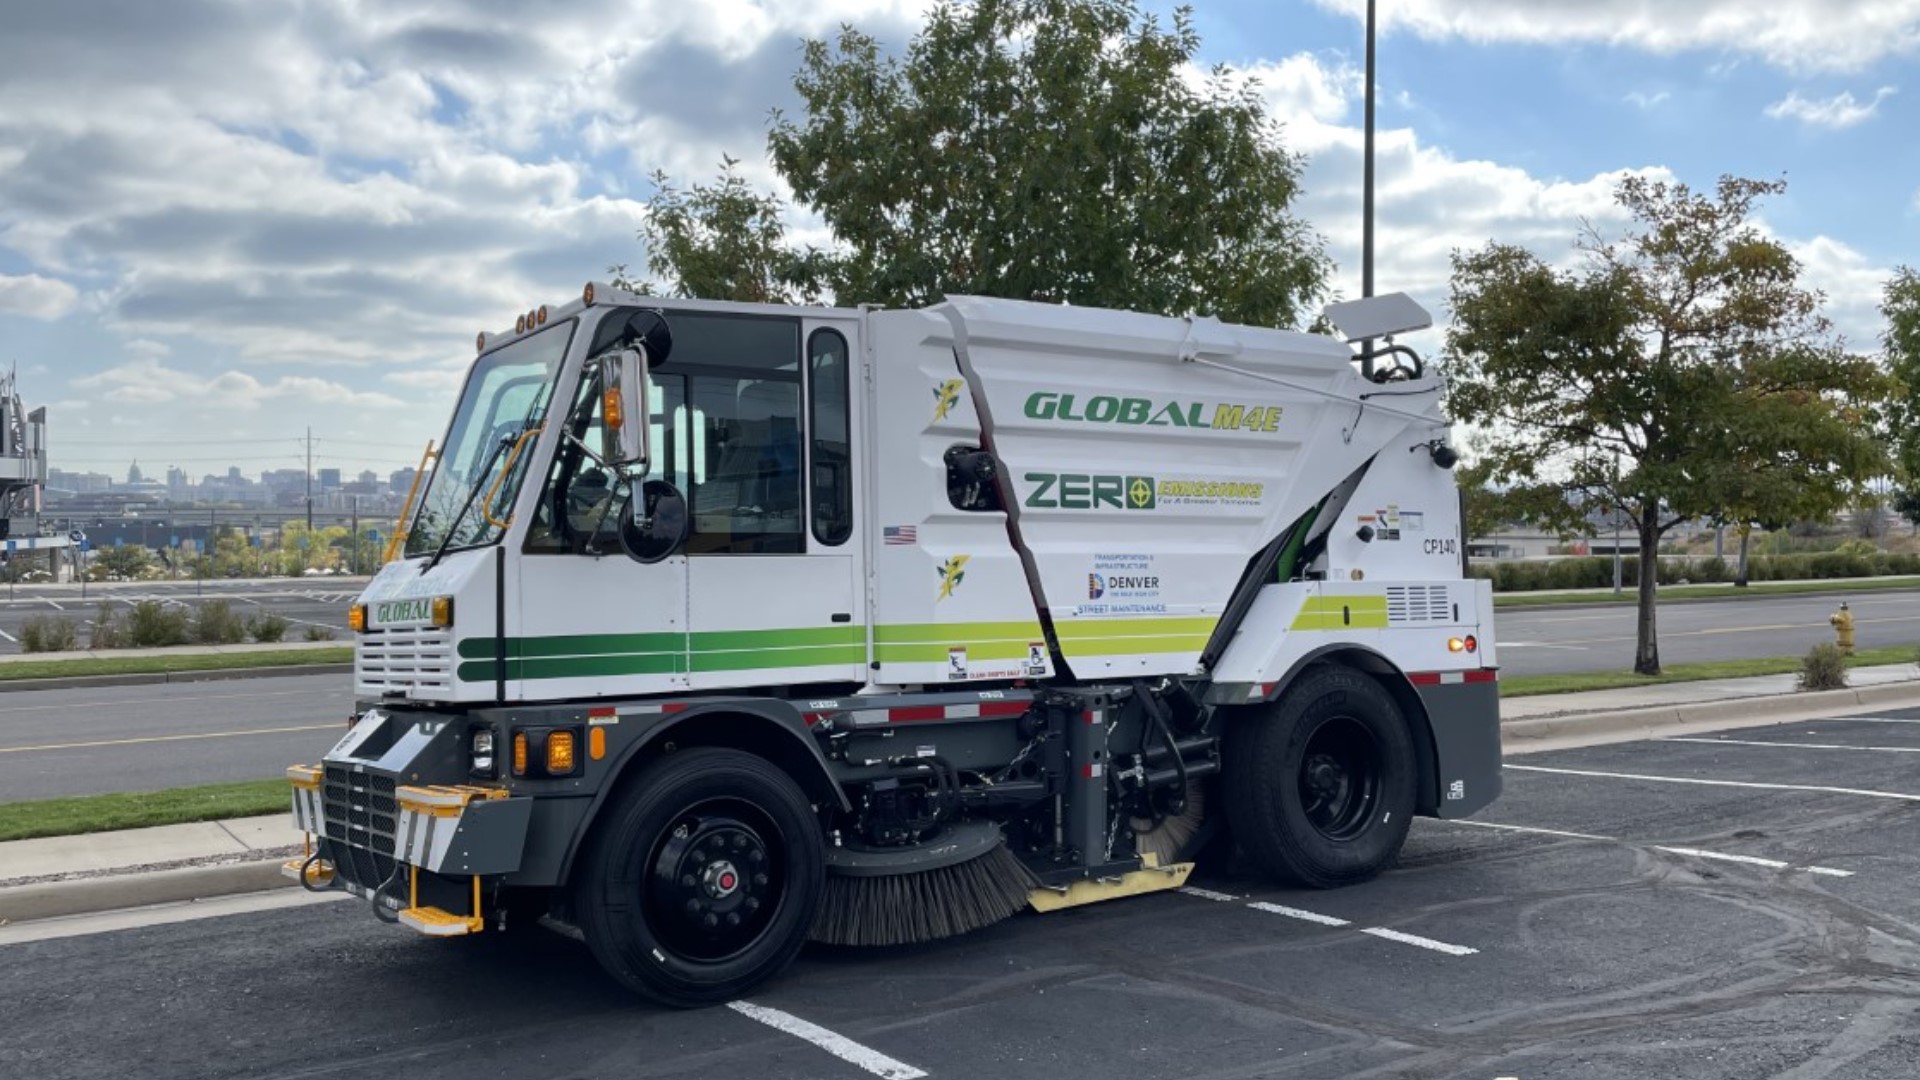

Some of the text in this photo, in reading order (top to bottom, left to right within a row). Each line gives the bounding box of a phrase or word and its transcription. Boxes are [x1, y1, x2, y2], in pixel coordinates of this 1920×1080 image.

[1024, 391, 1283, 432] GLOBAL M4E
[1023, 472, 1155, 510] ZERO
[1157, 480, 1264, 498] EMISSIONS
[1109, 576, 1160, 589] DENVER
[377, 601, 431, 623] GLOBAL
[1078, 604, 1166, 614] STREET MAINTENANCE
